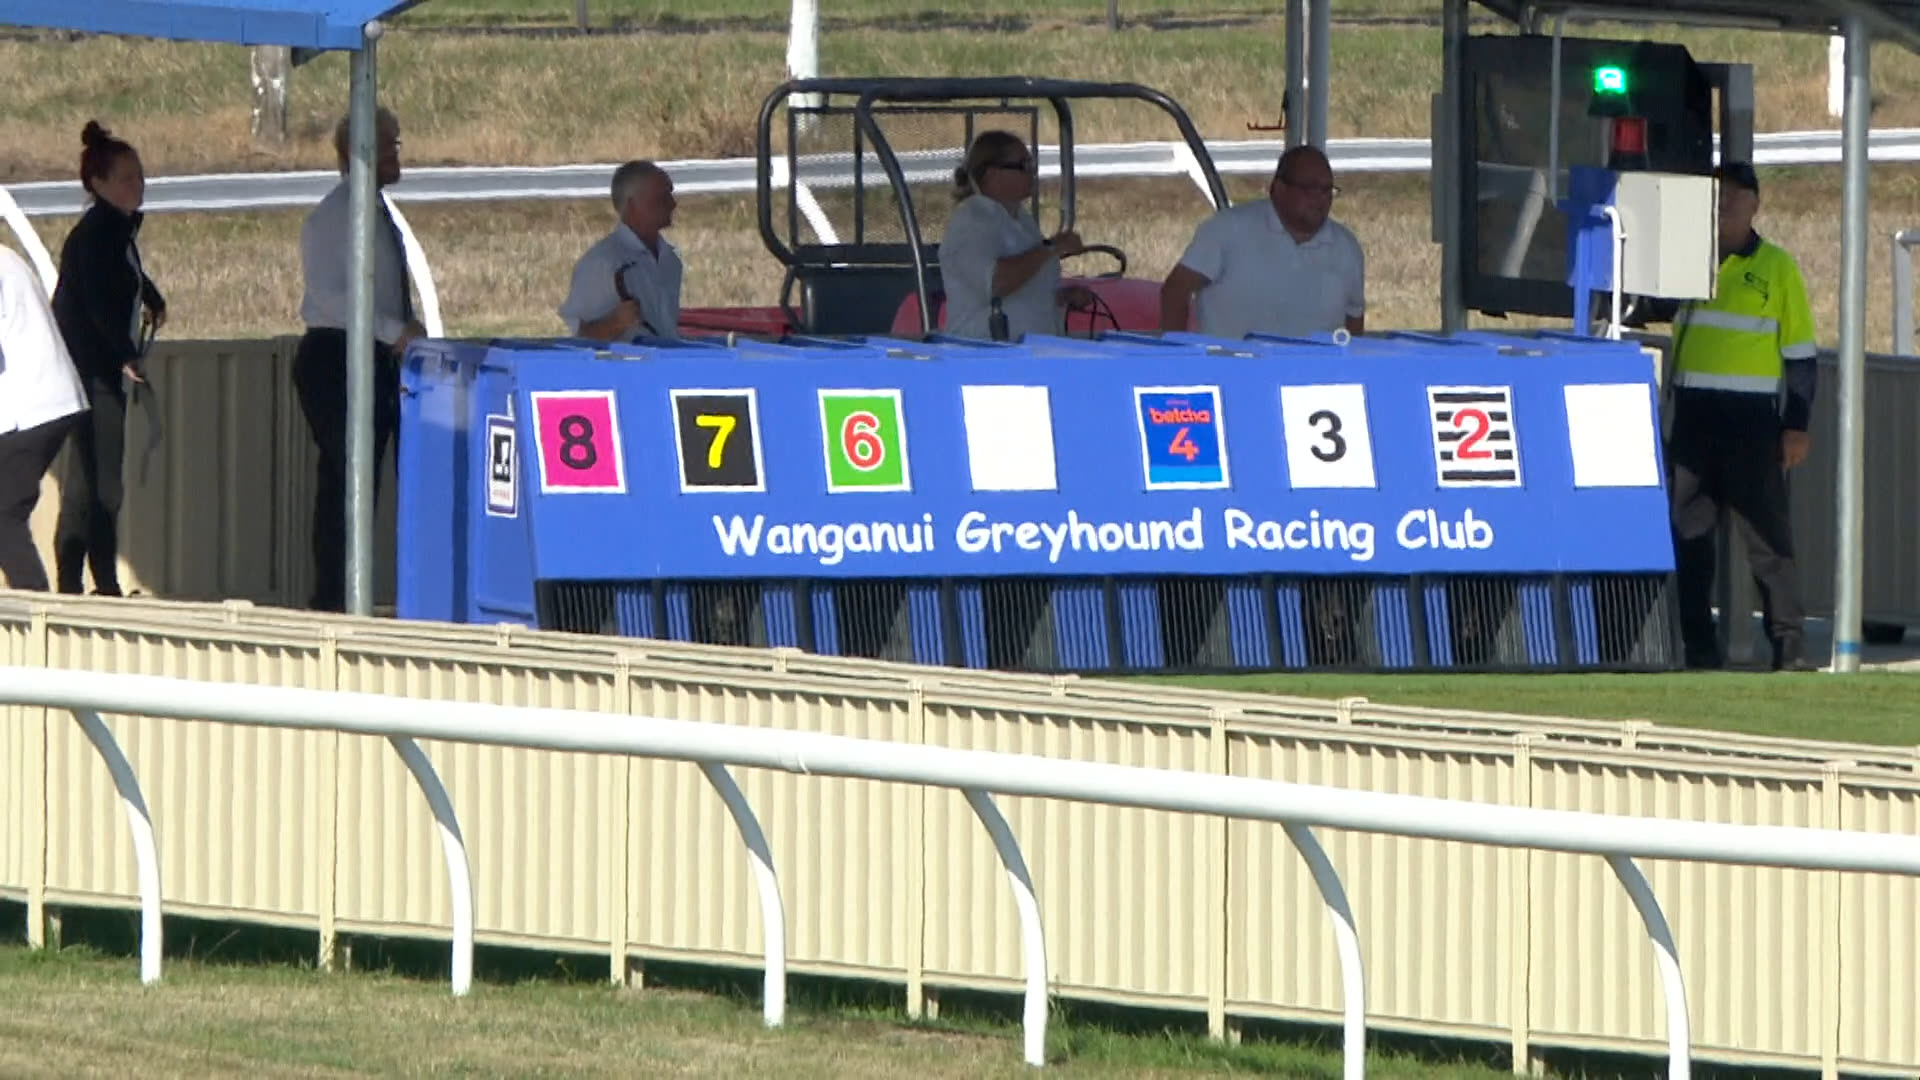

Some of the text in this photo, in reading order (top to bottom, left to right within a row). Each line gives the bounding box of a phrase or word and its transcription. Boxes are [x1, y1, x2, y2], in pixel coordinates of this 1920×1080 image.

[559, 415, 597, 470] 8
[695, 414, 736, 469] 7
[842, 411, 885, 471] 6
[1149, 408, 1211, 424] betcha
[1308, 410, 1347, 462] 3
[1453, 409, 1492, 459] 2
[1168, 427, 1200, 462] 4
[712, 507, 1494, 565] Wanganui Greyhound Racing Club
